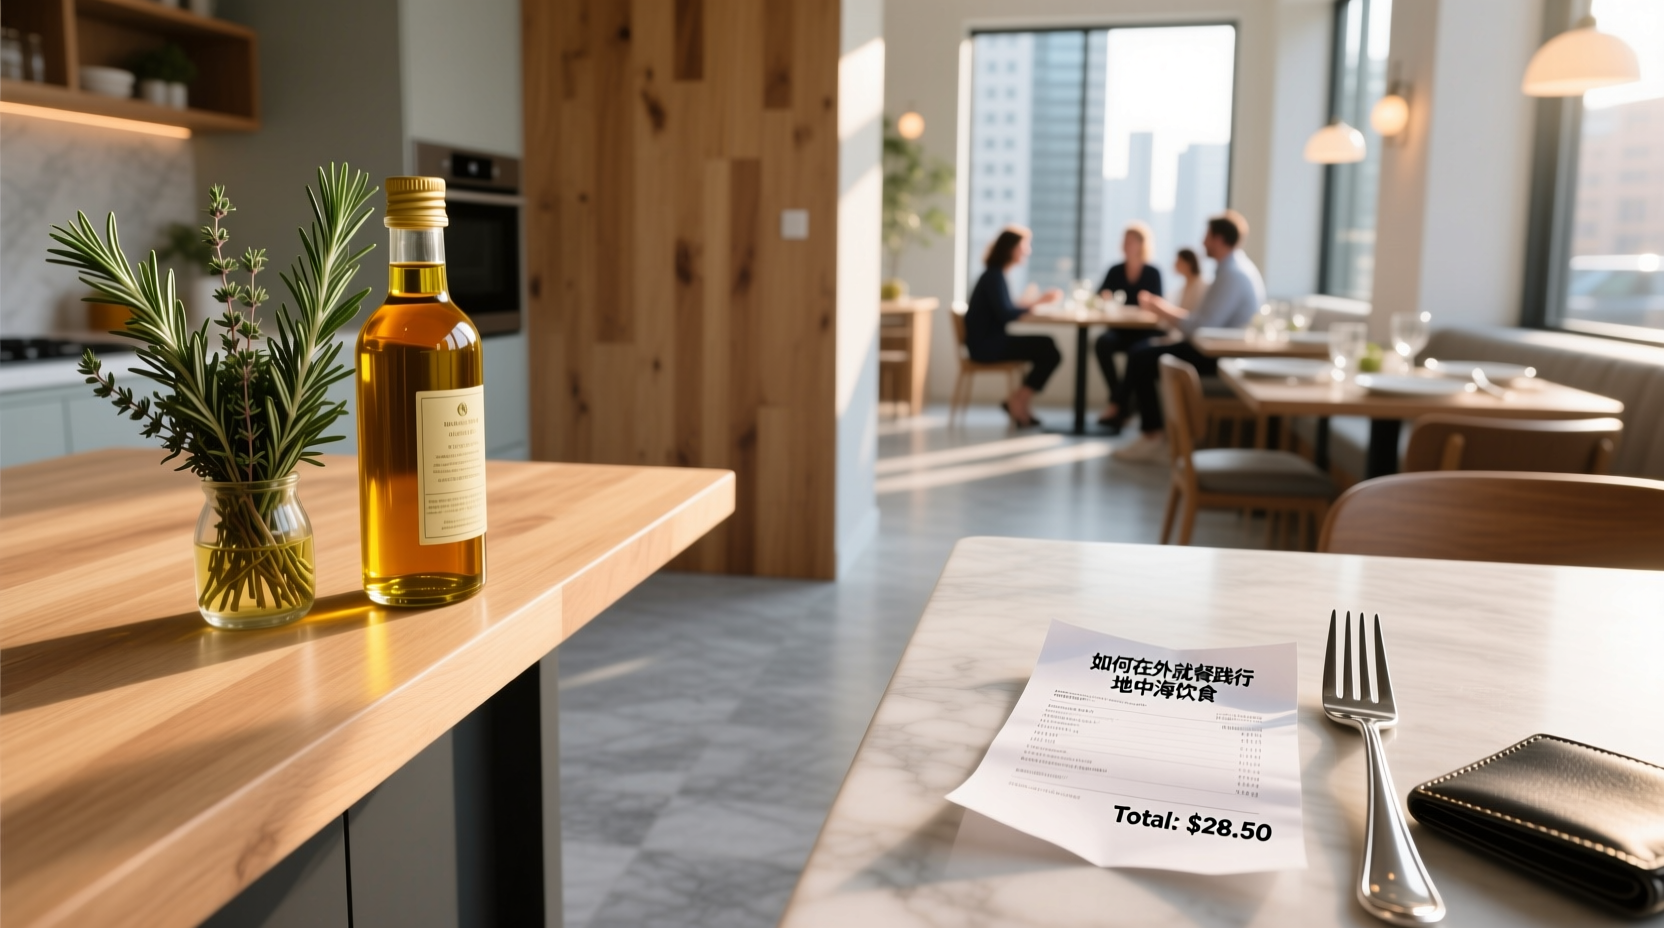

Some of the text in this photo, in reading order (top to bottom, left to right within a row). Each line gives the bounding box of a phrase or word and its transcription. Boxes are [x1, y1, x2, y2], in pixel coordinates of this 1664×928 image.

[1090, 652, 1255, 687] 如何在外就餐践行
[1111, 675, 1218, 702] 地中海饮食
[1113, 805, 1272, 842] Total: $28.50
